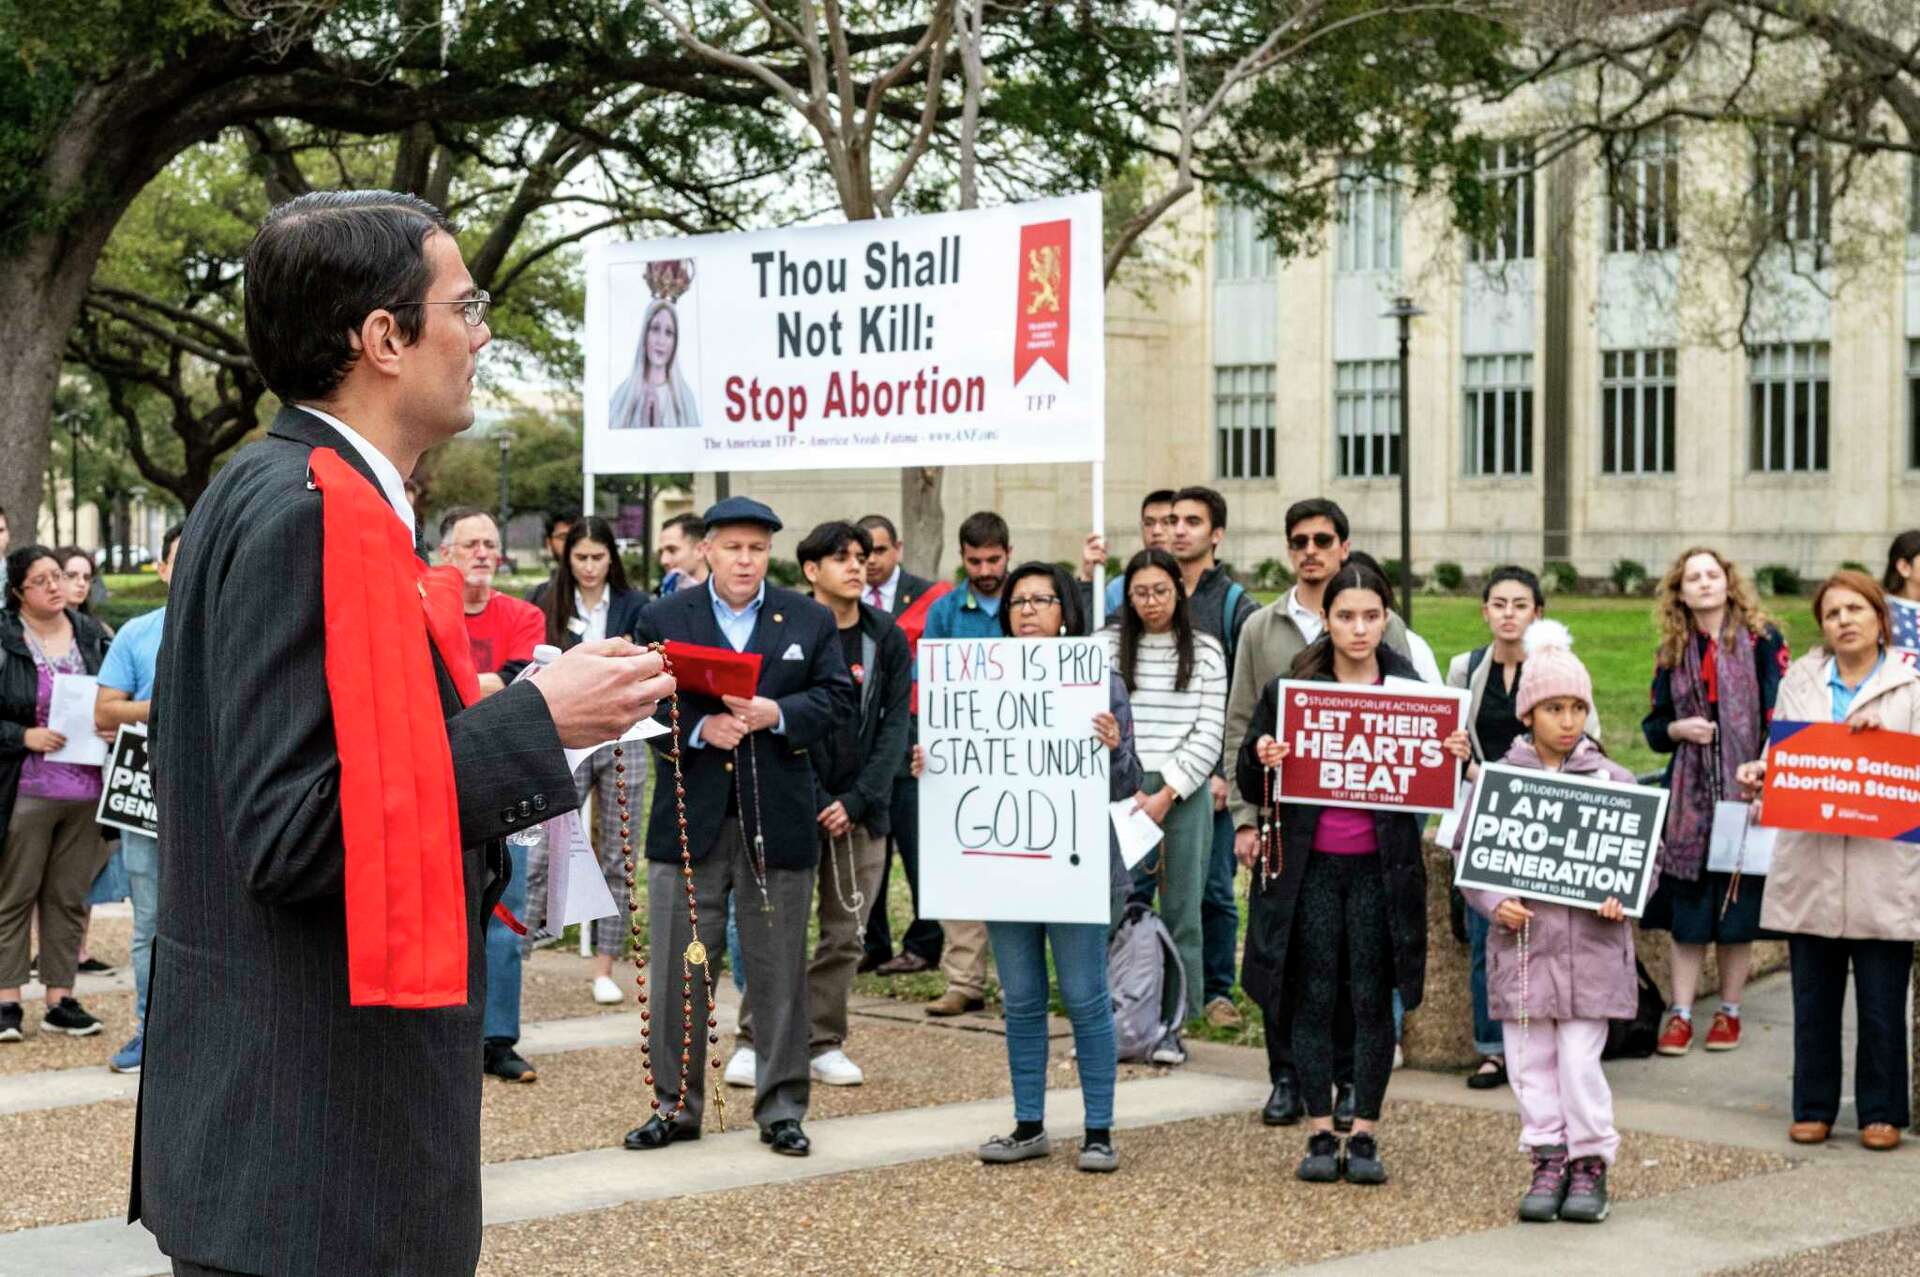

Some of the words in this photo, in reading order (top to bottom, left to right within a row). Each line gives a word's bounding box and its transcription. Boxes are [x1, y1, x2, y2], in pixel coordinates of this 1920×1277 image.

[752, 249, 847, 298] Thou
[864, 235, 961, 290] Shall
[777, 311, 843, 358] Not
[860, 303, 934, 355] Kill:
[725, 373, 808, 432] Stop
[823, 365, 986, 419] Abortion
[1026, 394, 1056, 411] TFP
[704, 437, 721, 449] The
[725, 437, 772, 449] American
[776, 435, 797, 448] TFP
[810, 435, 849, 447] America
[922, 643, 1004, 682] TEXAS
[1021, 644, 1047, 682] IS
[1058, 642, 1108, 685] PRO-
[997, 690, 1054, 731] ONE
[1303, 709, 1351, 732] LET
[1360, 713, 1438, 738] THEIR
[124, 749, 134, 767] I
[928, 737, 1018, 776] STATE
[1027, 736, 1106, 780] UNDER
[1295, 730, 1445, 768] HEARTS
[1774, 750, 1853, 771] Remove
[1319, 761, 1417, 795] BEAT
[1350, 790, 1366, 801] LIFE
[1522, 782, 1632, 810] STUDENTSFORLIFE.ORG
[1773, 772, 1861, 795] Abortion
[1864, 780, 1920, 803] Statu
[1487, 791, 1499, 812] I
[1510, 796, 1564, 823] AM
[1578, 805, 1641, 835] THE
[1472, 813, 1647, 870] PRO-LIFE
[1470, 846, 1636, 895] GENERATION
[1512, 877, 1530, 888] TEXT
[1530, 880, 1547, 892] LIFE
